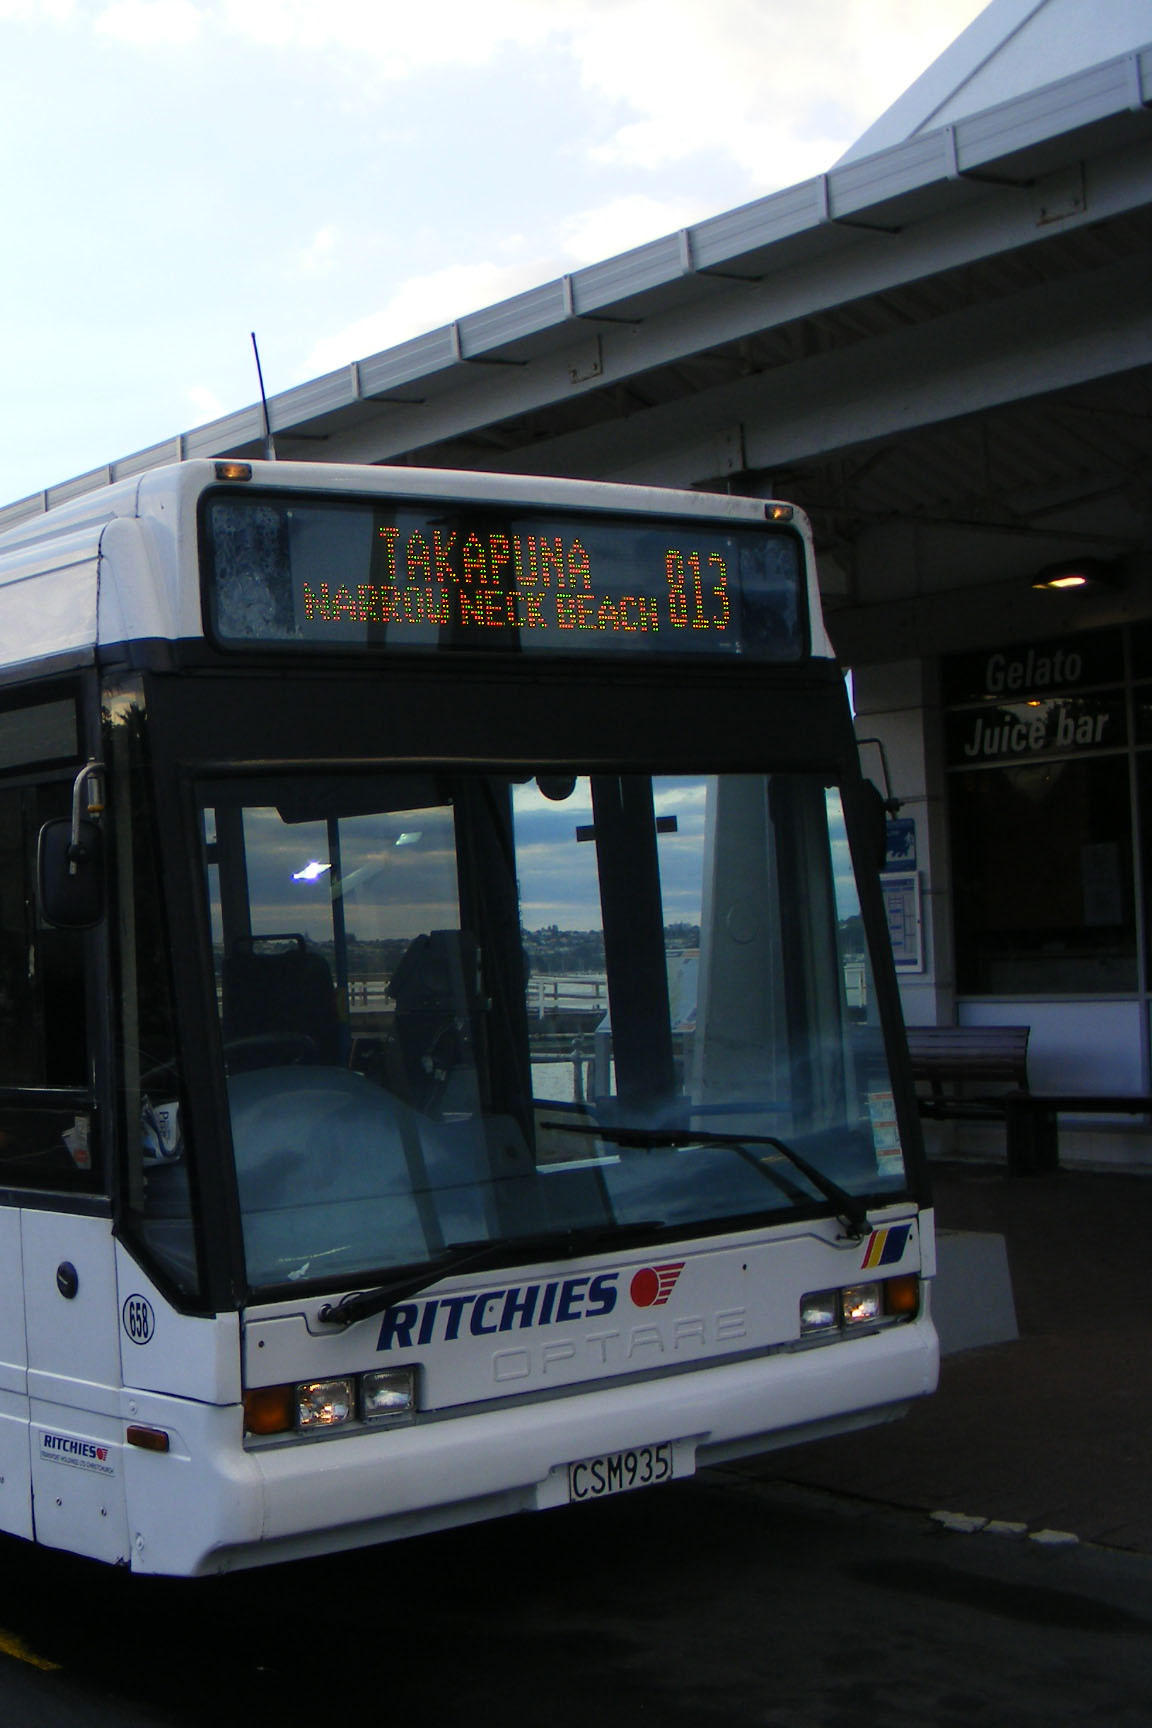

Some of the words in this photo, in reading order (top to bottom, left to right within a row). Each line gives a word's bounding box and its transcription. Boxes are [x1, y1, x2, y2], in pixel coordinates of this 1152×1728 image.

[378, 526, 592, 589] TAKAPUNA
[303, 582, 449, 624] NARROW
[459, 588, 548, 628] NECK
[556, 593, 659, 632] BEACH
[986, 649, 1082, 692] Gelato
[964, 713, 1046, 756] Juice
[1056, 704, 1109, 746] bar
[129, 1301, 149, 1339] 658
[376, 1273, 620, 1351] RITCHIES
[493, 1307, 746, 1382] OPTARE
[43, 1434, 96, 1459] RITCHIES
[572, 1445, 669, 1499] CSM935
